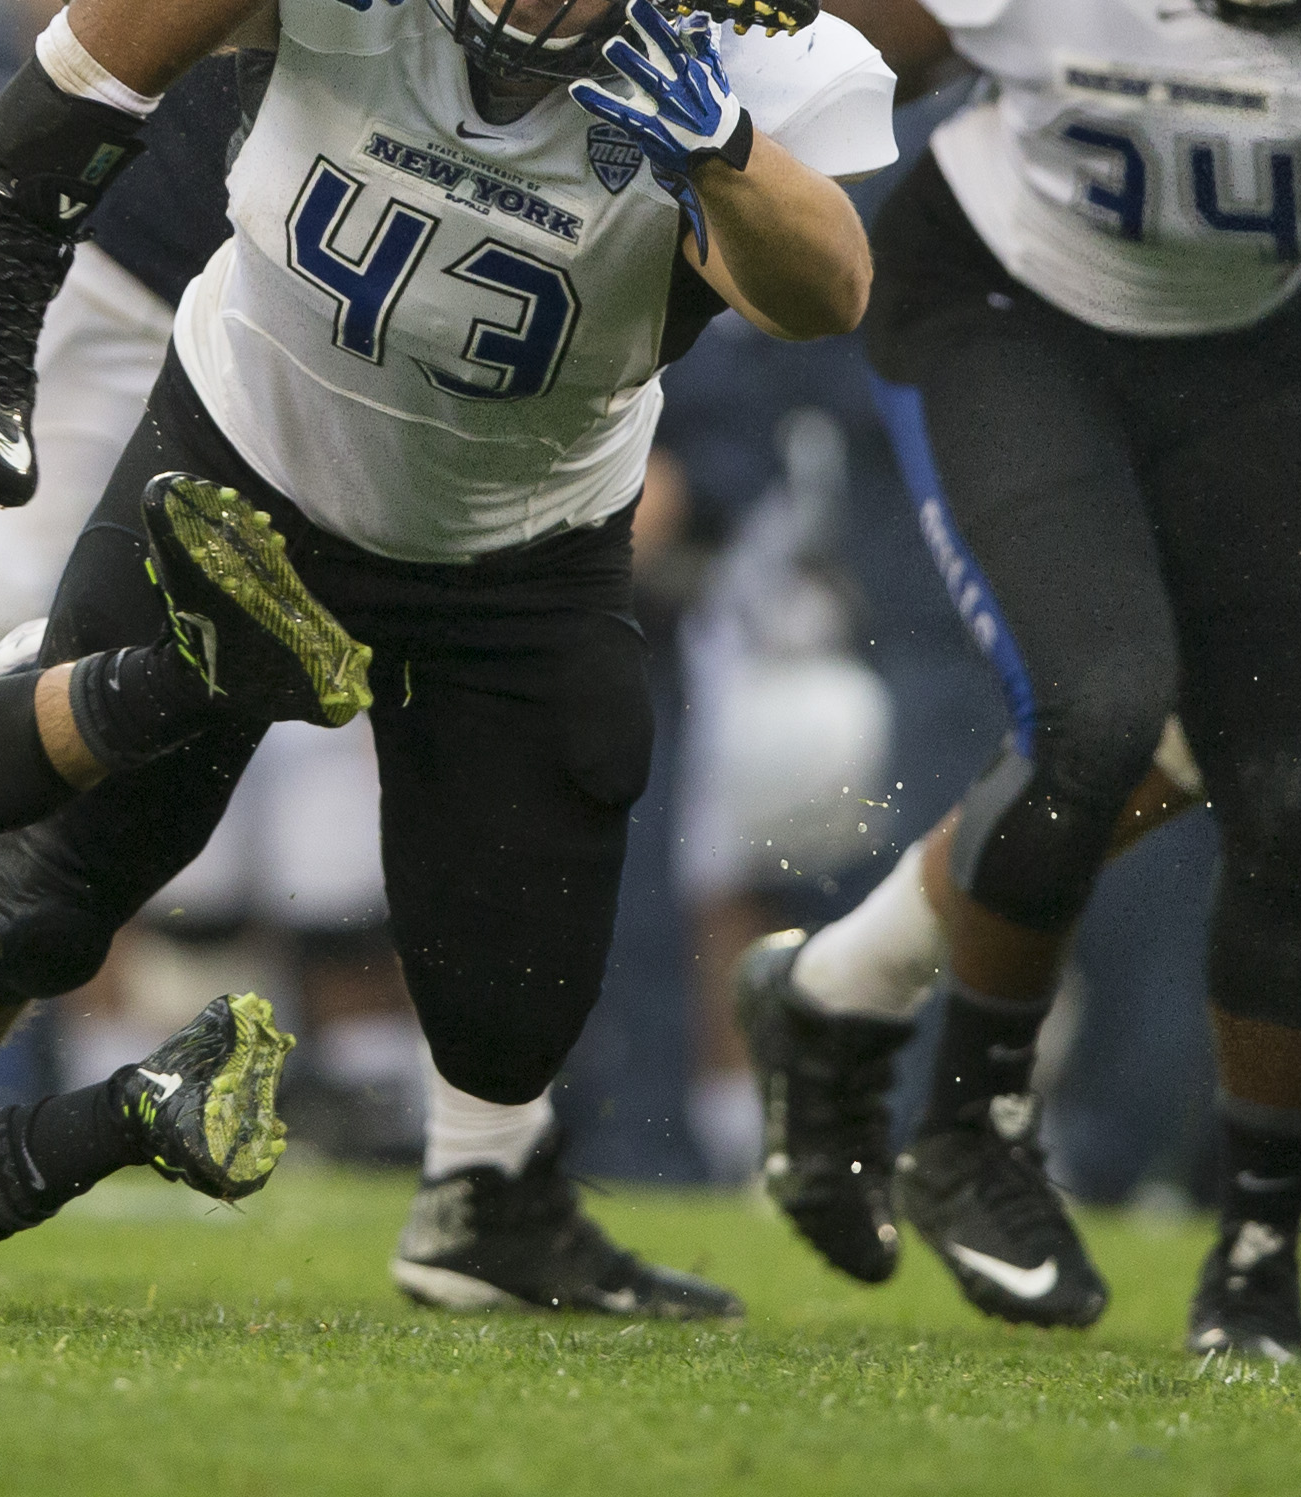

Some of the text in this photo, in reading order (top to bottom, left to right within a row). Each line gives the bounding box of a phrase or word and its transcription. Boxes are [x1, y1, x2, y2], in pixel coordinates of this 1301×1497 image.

[363, 132, 584, 245] NEW YORK
[427, 142, 542, 193] STATE UNIVERSITY OF
[444, 192, 491, 216] BUFFALO
[285, 154, 582, 402] 43
